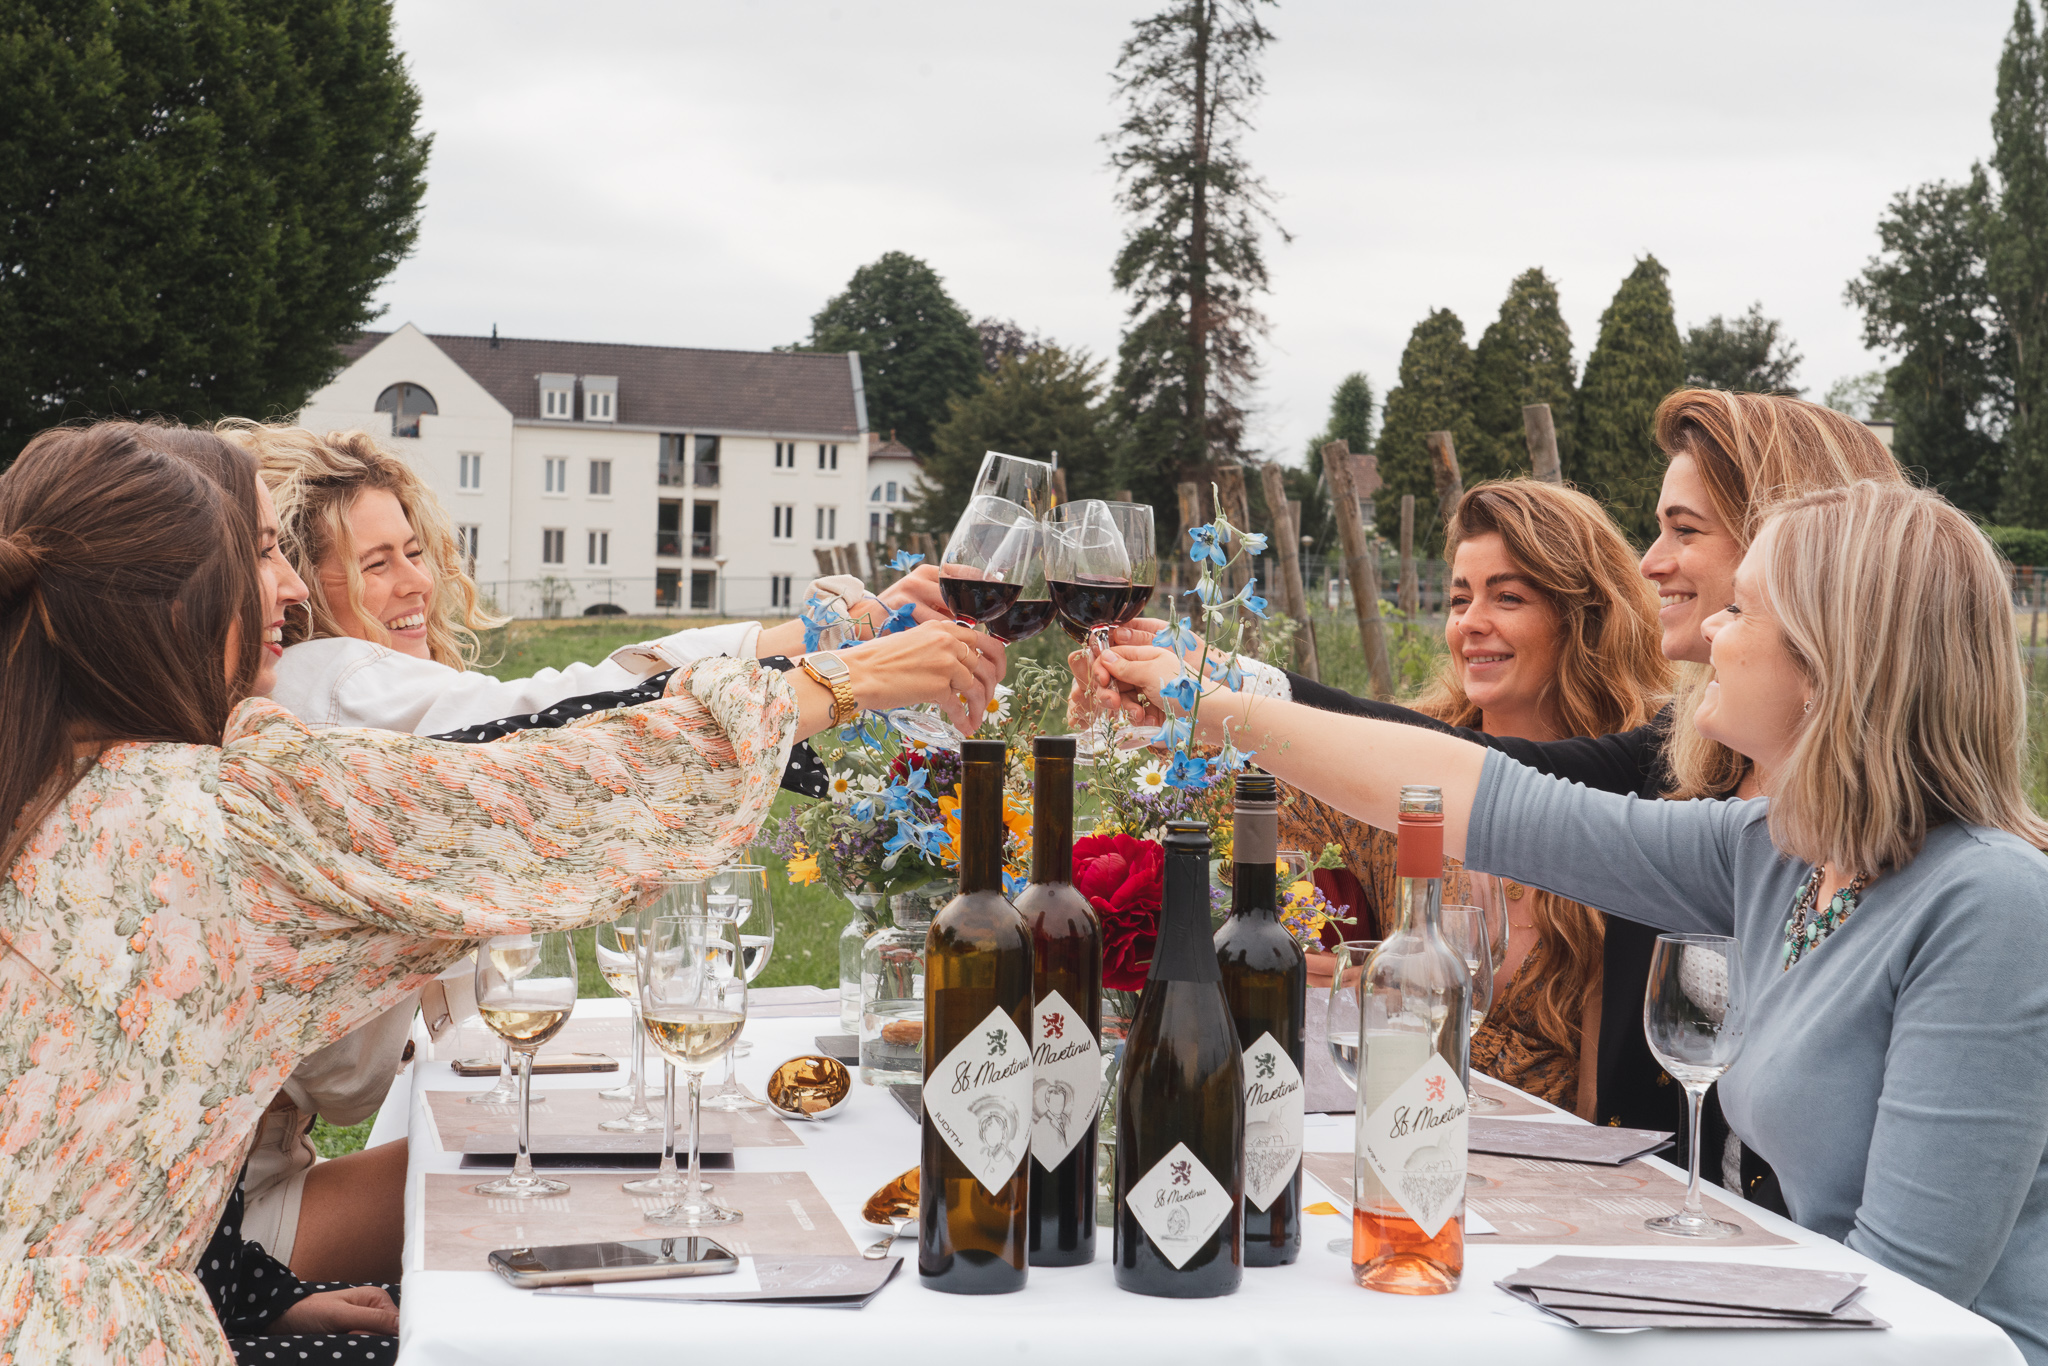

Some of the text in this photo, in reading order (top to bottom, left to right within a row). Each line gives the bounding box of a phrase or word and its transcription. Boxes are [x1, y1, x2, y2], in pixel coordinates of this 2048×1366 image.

[1033, 1040, 1091, 1067] Martinus
[973, 1055, 1030, 1088] Martinus
[1246, 1079, 1299, 1107] Martinus
[934, 1111, 964, 1148] JUDITH
[1166, 1187, 1207, 1205] Martinus
